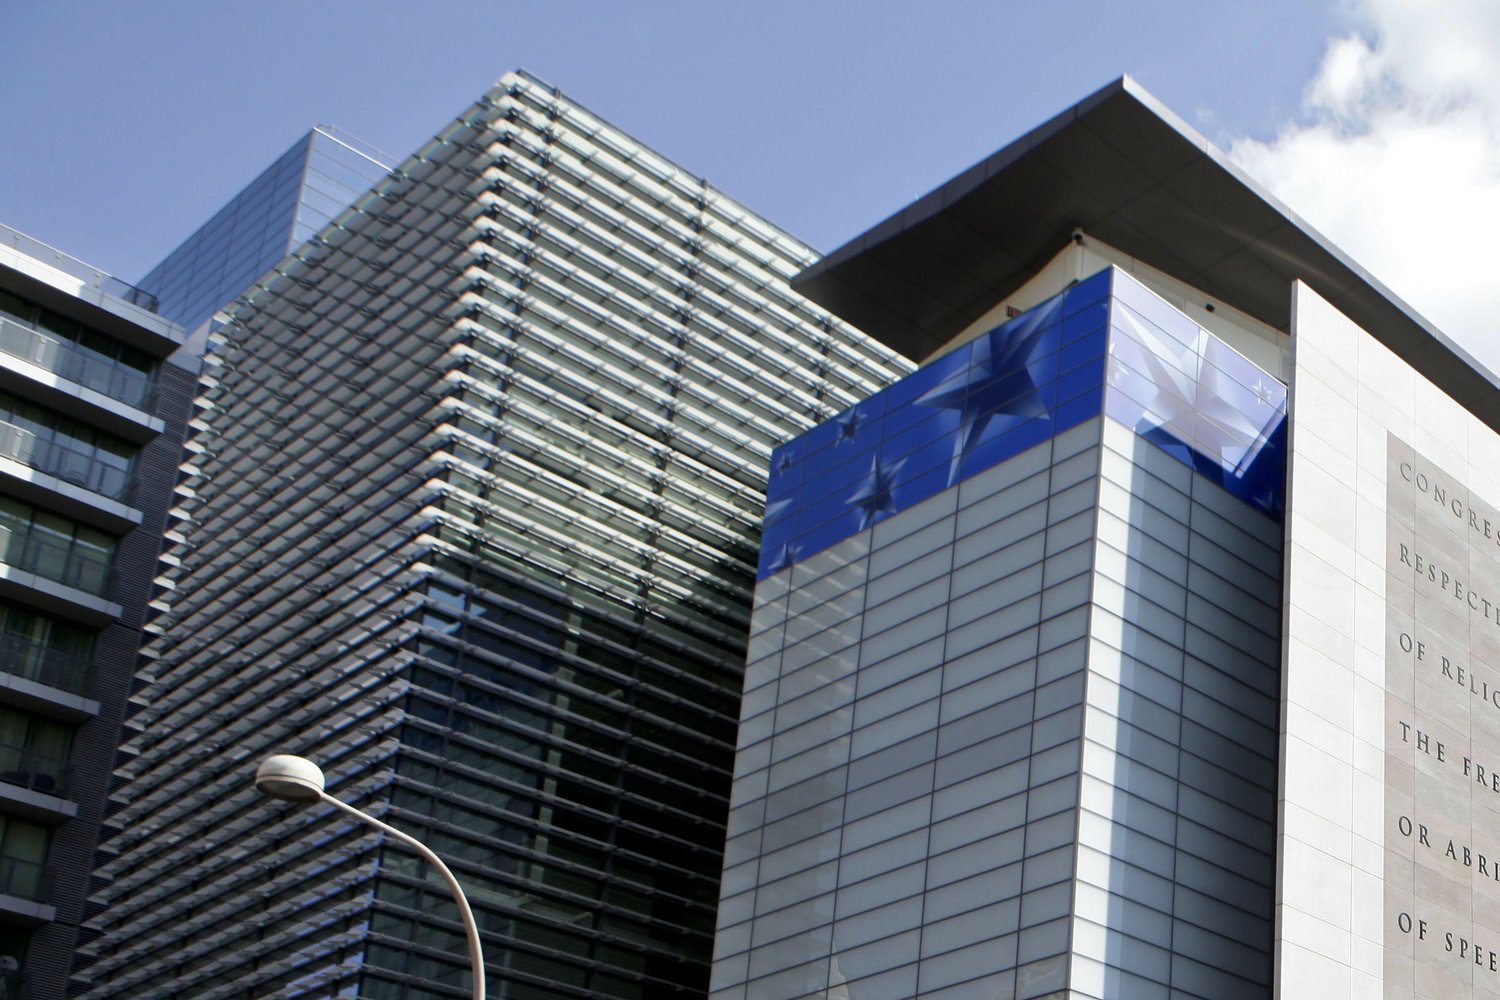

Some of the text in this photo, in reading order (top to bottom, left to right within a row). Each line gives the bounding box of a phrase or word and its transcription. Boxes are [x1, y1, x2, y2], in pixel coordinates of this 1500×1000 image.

[1400, 633, 1425, 661] OF
[1400, 722, 1445, 763] THE
[1399, 816, 1430, 848] OR
[1399, 913, 1427, 941] OF
